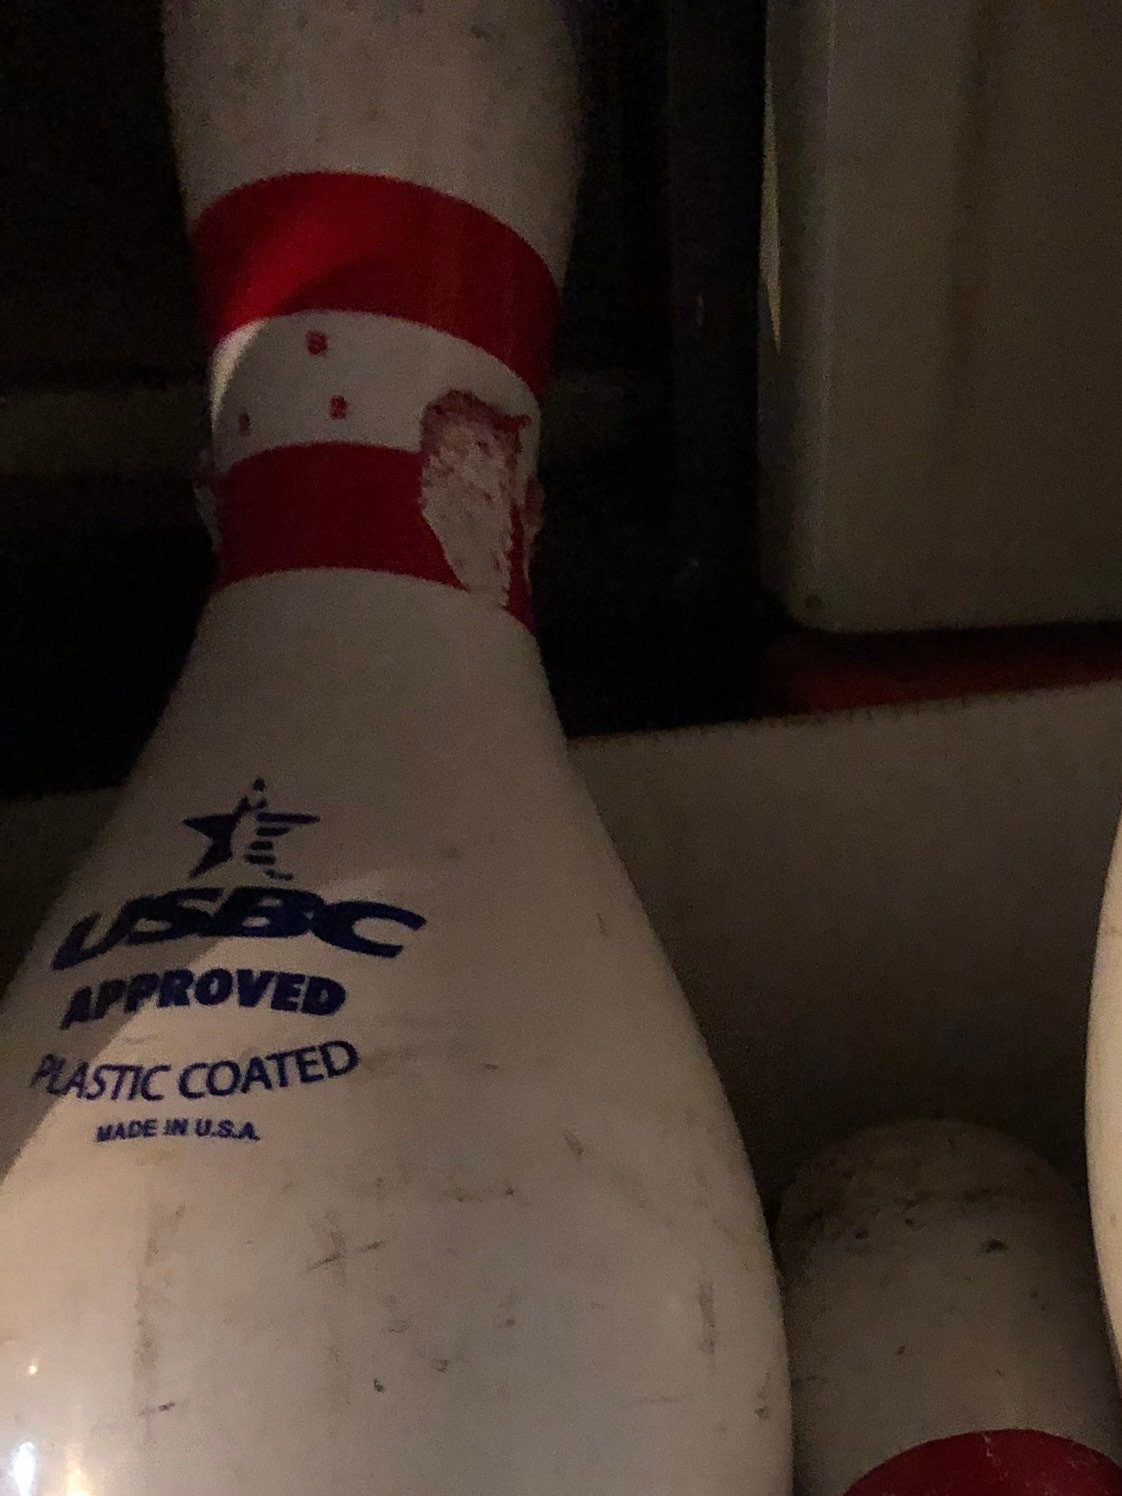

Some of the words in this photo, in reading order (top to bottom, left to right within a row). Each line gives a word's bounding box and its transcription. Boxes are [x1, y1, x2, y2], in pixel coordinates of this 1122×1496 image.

[51, 886, 427, 971] USBC
[60, 968, 347, 1030] APPROVED
[29, 1052, 171, 1101] PLASTIC
[178, 1040, 360, 1100] COATED
[97, 1119, 158, 1143] MADE
[164, 1116, 189, 1137] IN
